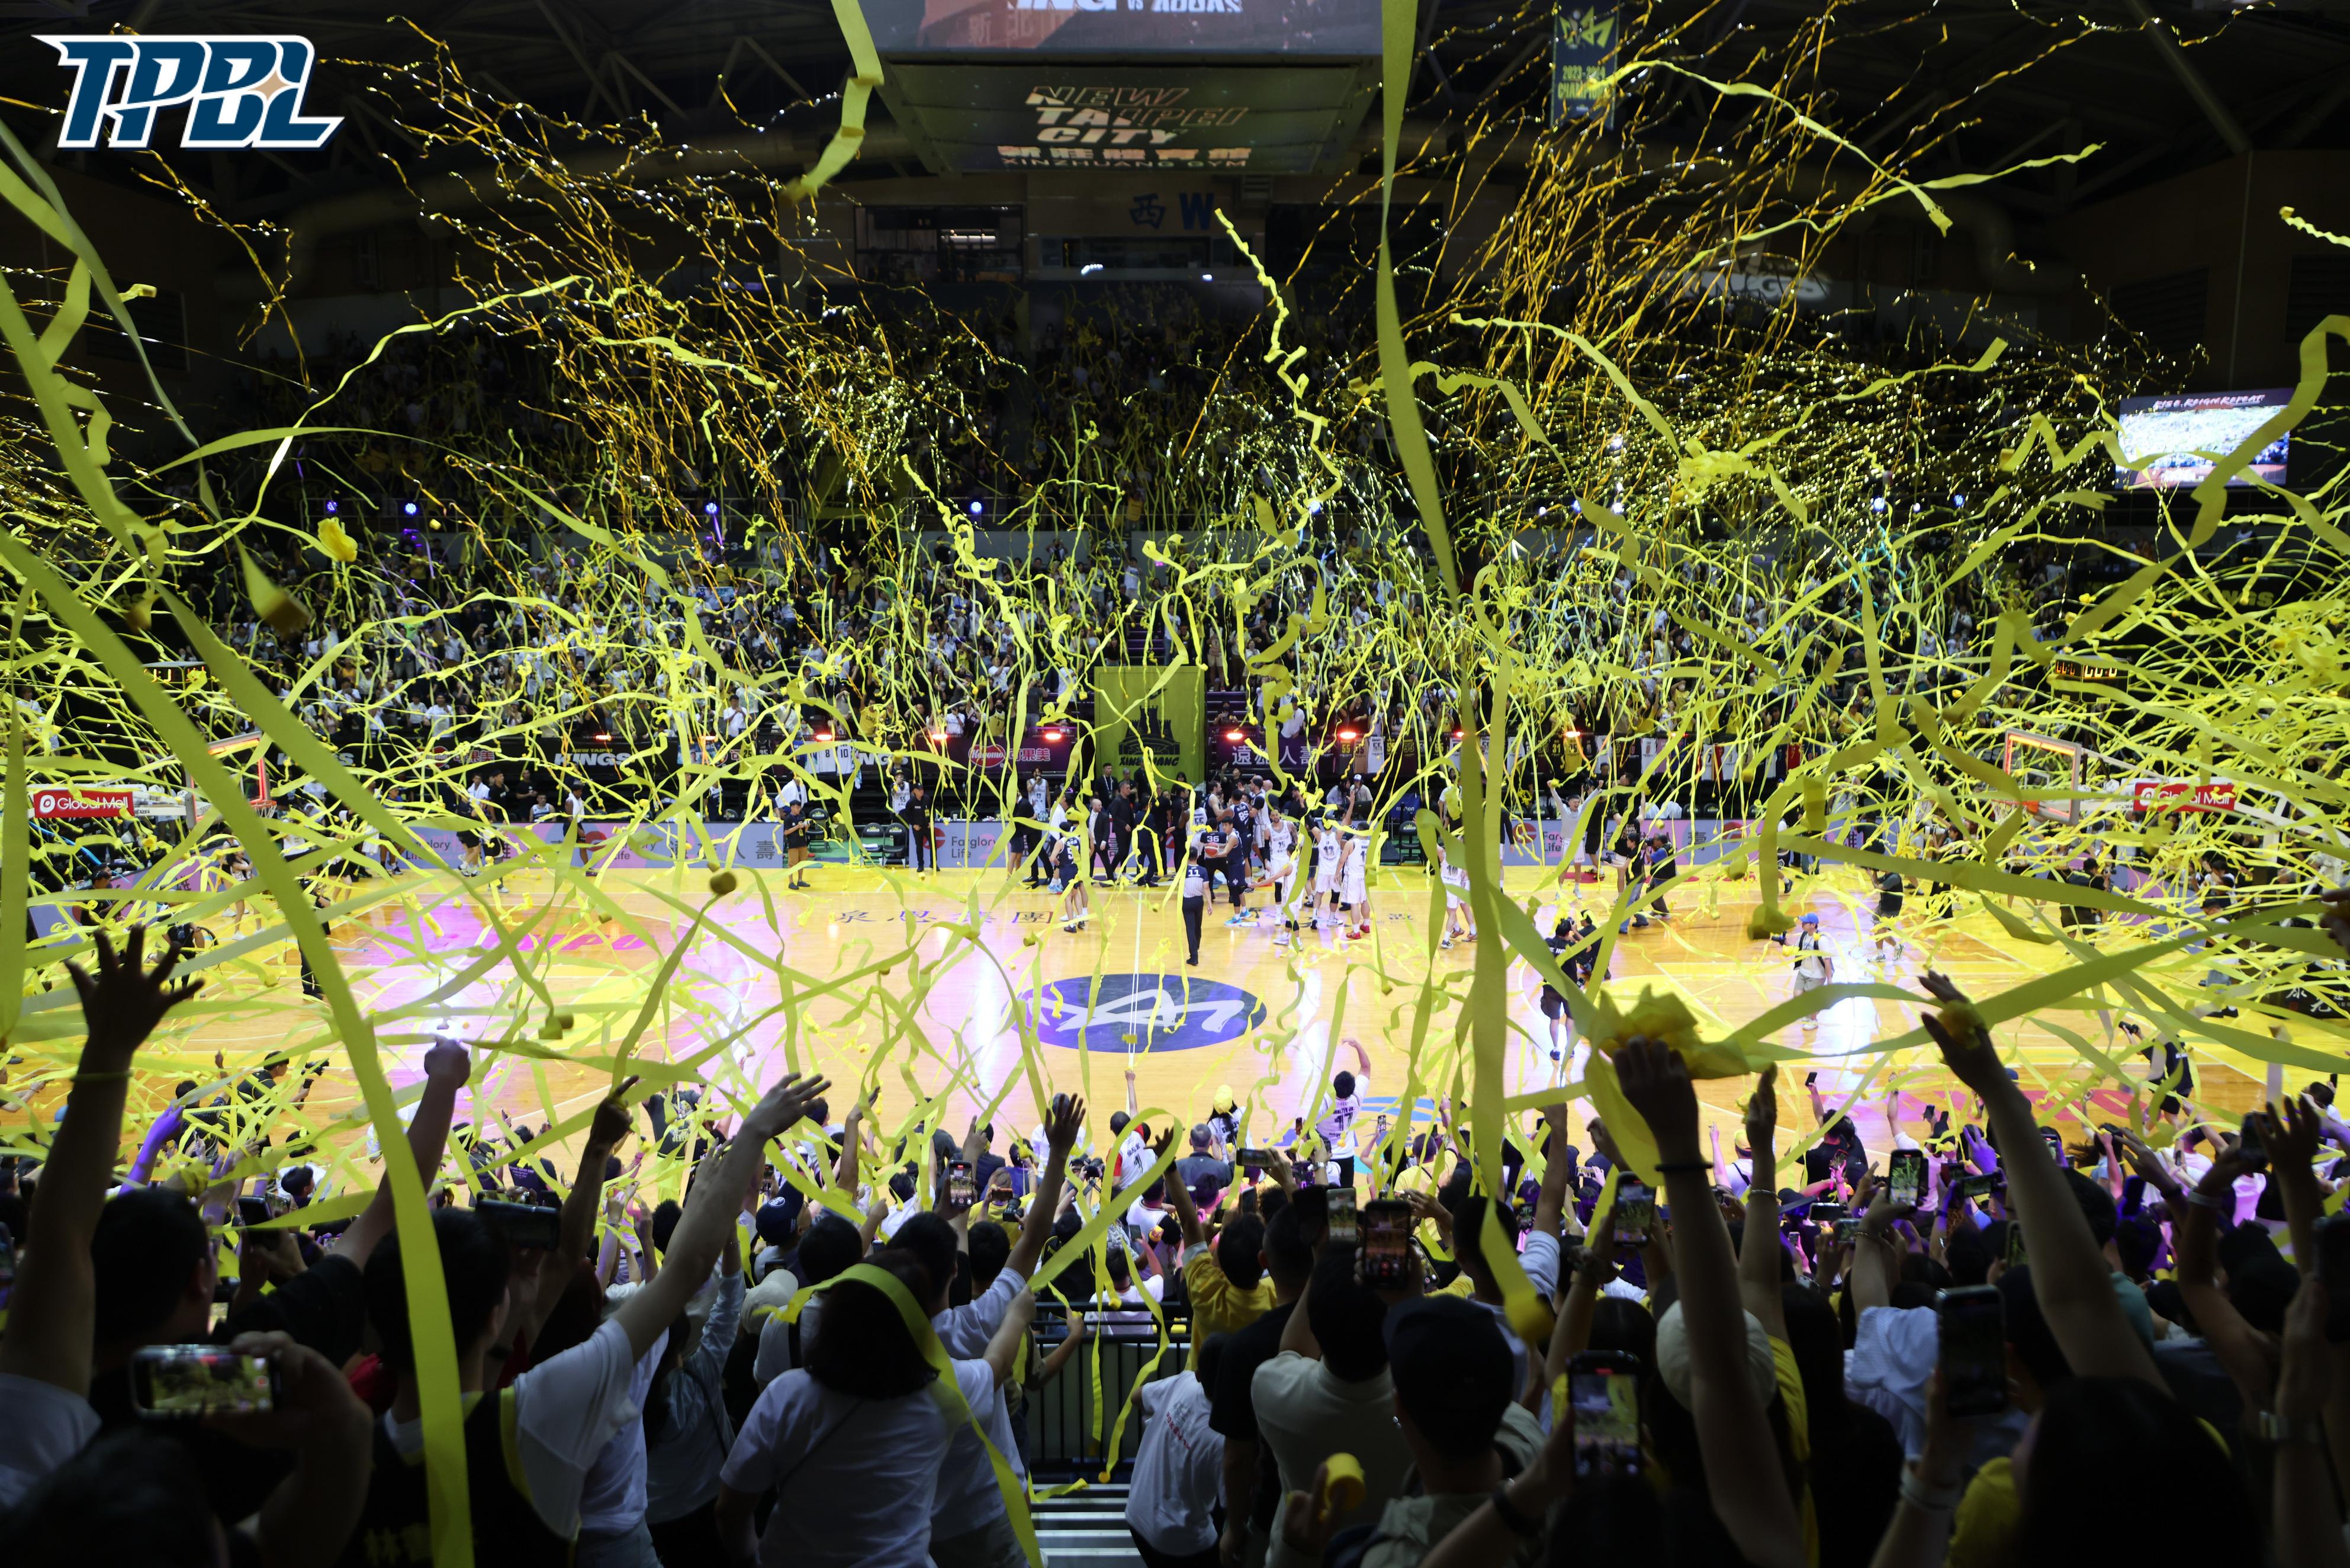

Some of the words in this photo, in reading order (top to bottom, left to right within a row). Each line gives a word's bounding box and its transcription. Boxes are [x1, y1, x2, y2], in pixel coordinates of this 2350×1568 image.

[1025, 86, 1190, 106] NEW
[1036, 107, 1249, 127] TAIPEI
[1037, 127, 1189, 144] CITY
[1002, 158, 1175, 168] XINZHUANG
[1129, 192, 1167, 230] 西
[1179, 192, 1214, 230] W
[840, 748, 848, 758] 10
[1342, 744, 1351, 753] 55
[1552, 743, 1561, 753] 31
